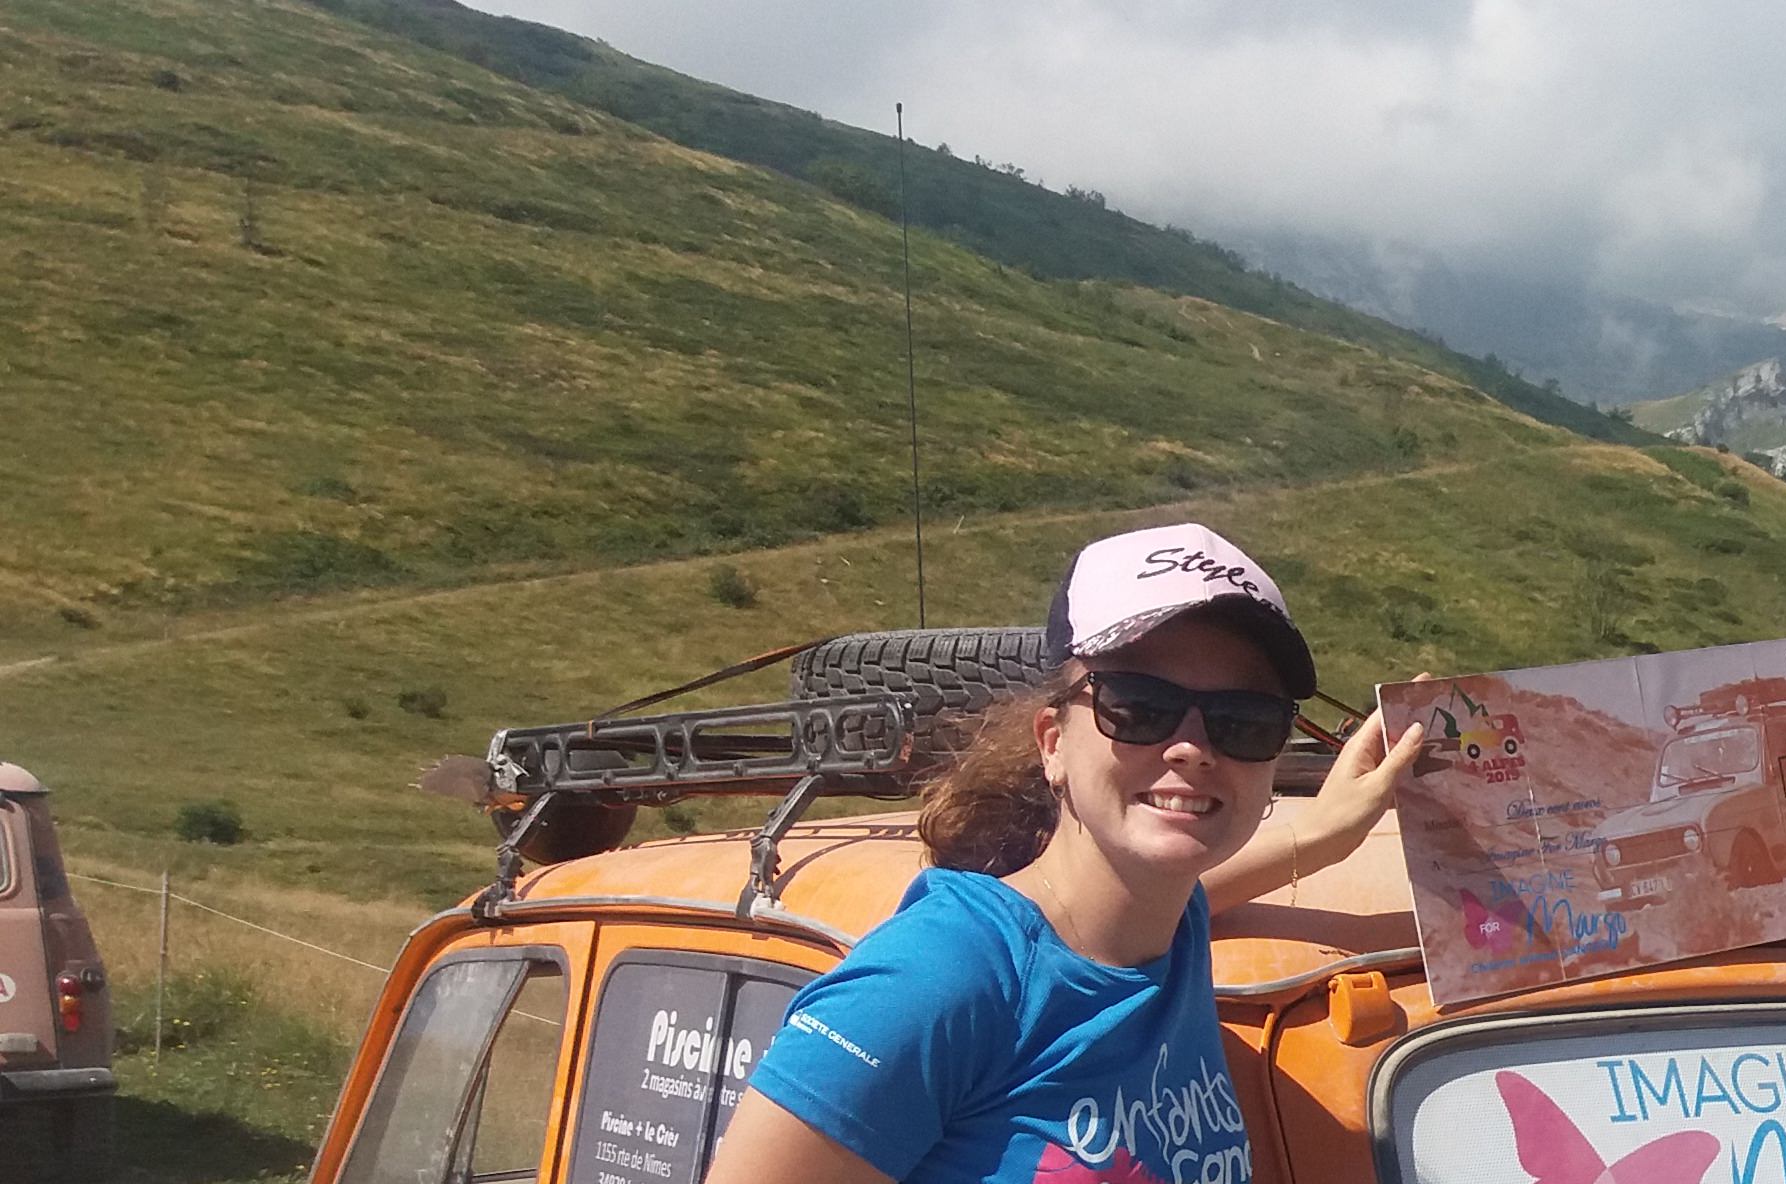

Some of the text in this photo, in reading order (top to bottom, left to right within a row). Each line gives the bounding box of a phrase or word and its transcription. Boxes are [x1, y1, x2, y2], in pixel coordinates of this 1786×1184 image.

[1479, 895, 1628, 950] FOR Margo
[647, 1009, 752, 1080] Piscine
[641, 1068, 650, 1090] 2
[649, 1073, 693, 1100] magasins
[1065, 1043, 1245, 1165] enfants
[631, 1149, 643, 1171] de
